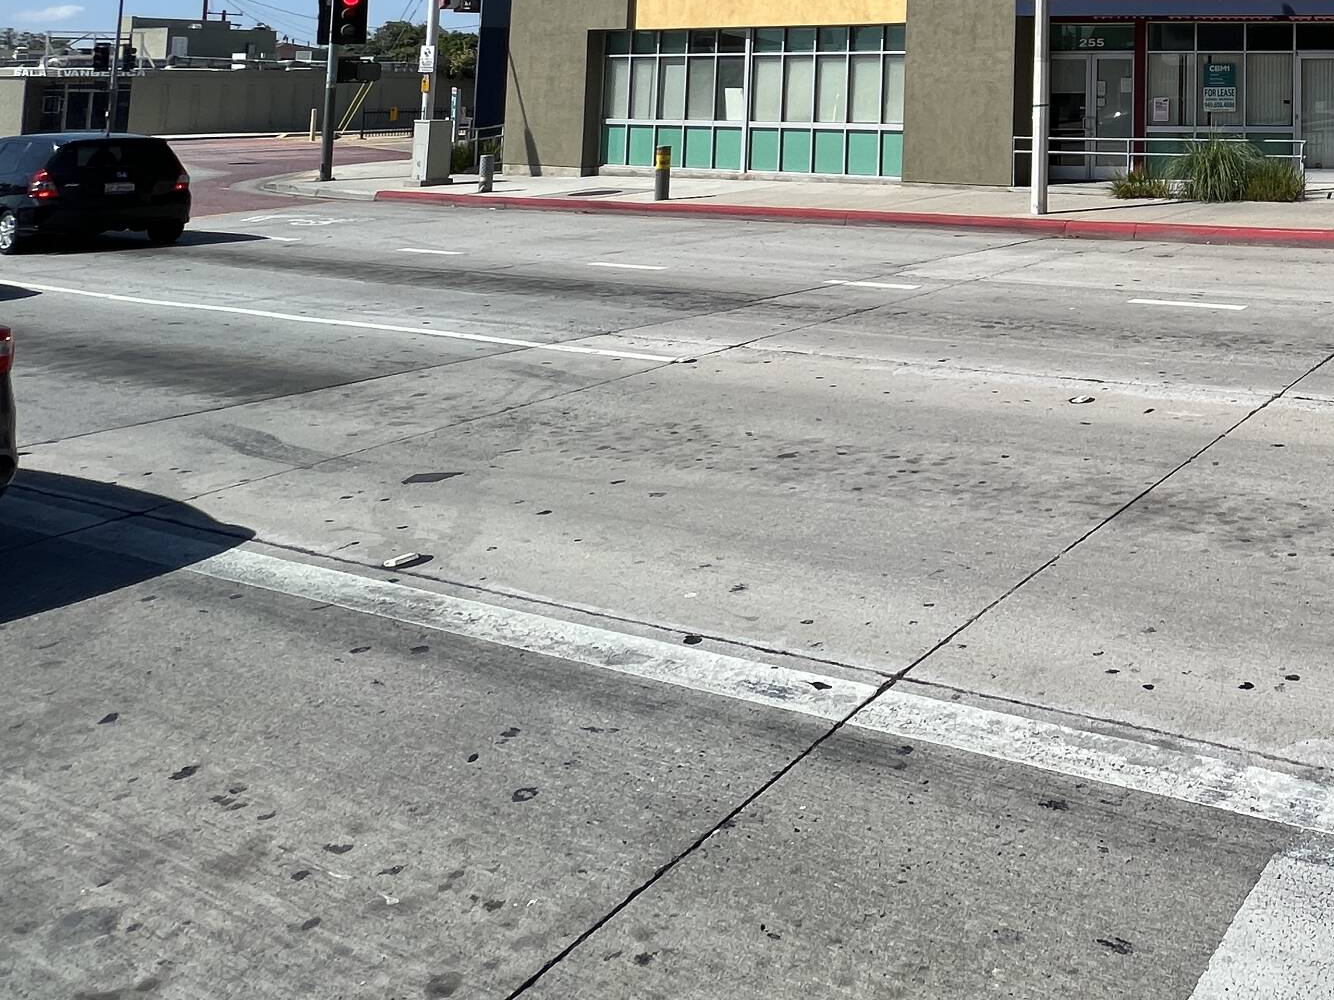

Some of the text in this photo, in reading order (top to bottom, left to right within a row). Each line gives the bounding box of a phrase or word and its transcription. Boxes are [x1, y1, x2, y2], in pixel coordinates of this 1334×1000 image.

[1079, 38, 1105, 47] 255
[1204, 89, 1235, 97] FOR LEASE
